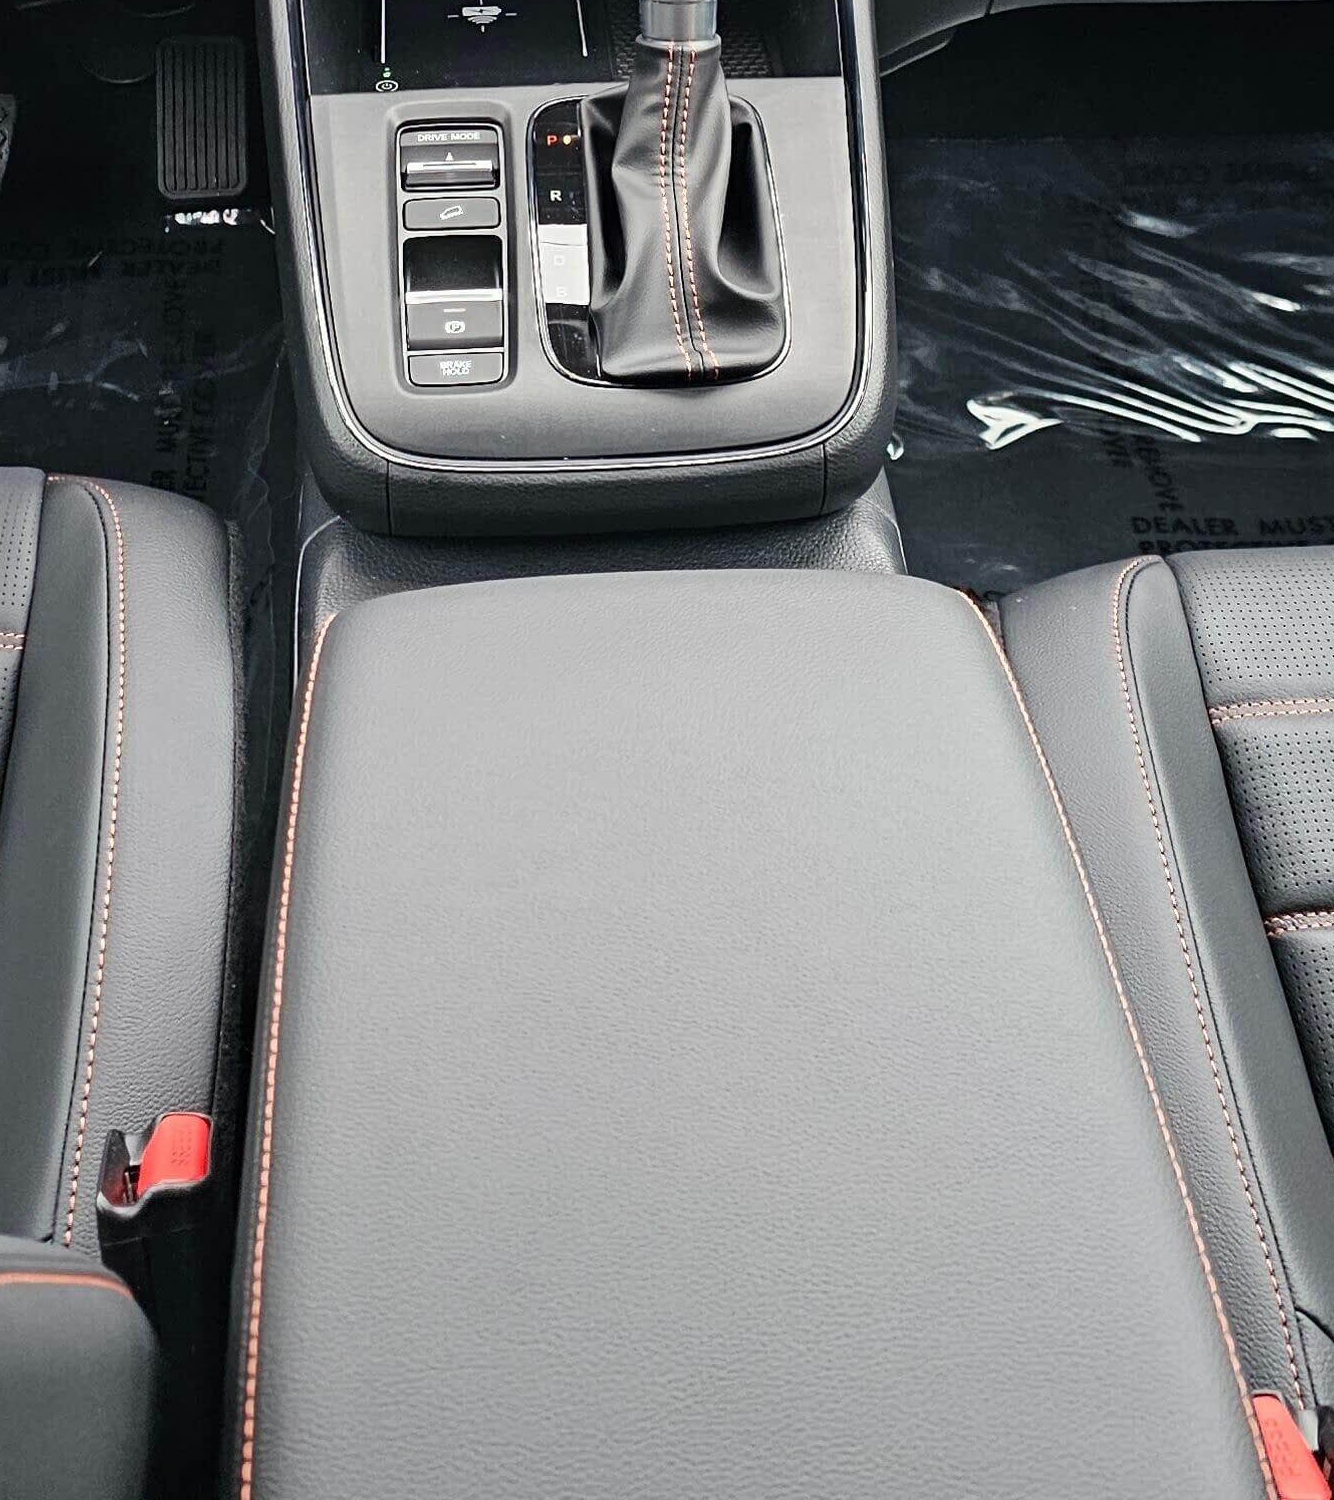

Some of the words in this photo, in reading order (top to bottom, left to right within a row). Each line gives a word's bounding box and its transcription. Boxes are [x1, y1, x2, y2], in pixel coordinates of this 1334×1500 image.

[417, 132, 448, 142] DRIVE
[450, 131, 481, 141] MODE
[547, 135, 558, 146] P
[550, 190, 563, 202] R
[439, 360, 472, 369] BRAKE
[442, 367, 470, 376] HOLD
[1130, 516, 1240, 536] DEALER
